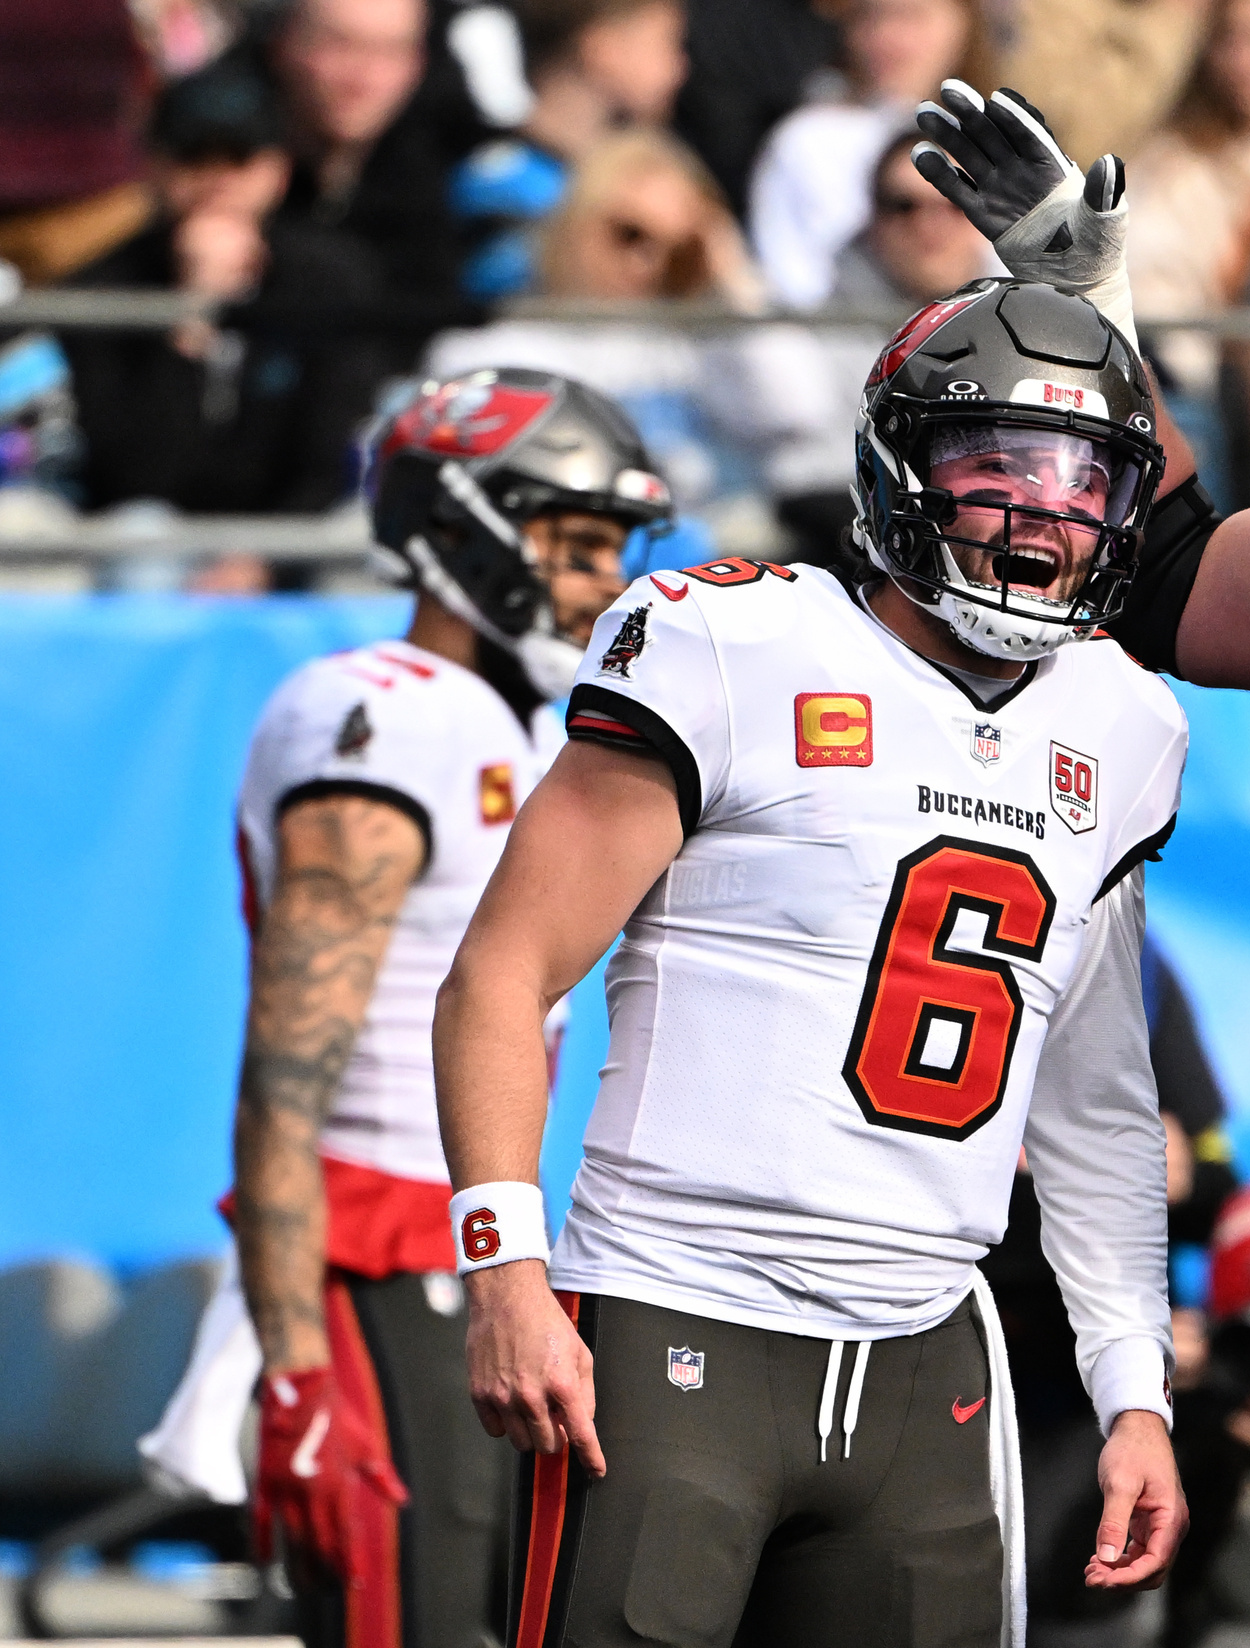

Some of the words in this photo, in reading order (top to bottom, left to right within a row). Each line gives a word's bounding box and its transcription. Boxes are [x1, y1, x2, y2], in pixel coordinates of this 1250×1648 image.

[1043, 383, 1084, 409] BUCS
[802, 697, 867, 747] C
[976, 738, 1000, 759] NFL
[1055, 752, 1092, 803] 50
[916, 784, 1046, 841] BUCCANEERS
[841, 834, 1057, 1142] 6
[461, 1207, 501, 1262] 6
[673, 1363, 698, 1384] NFL
